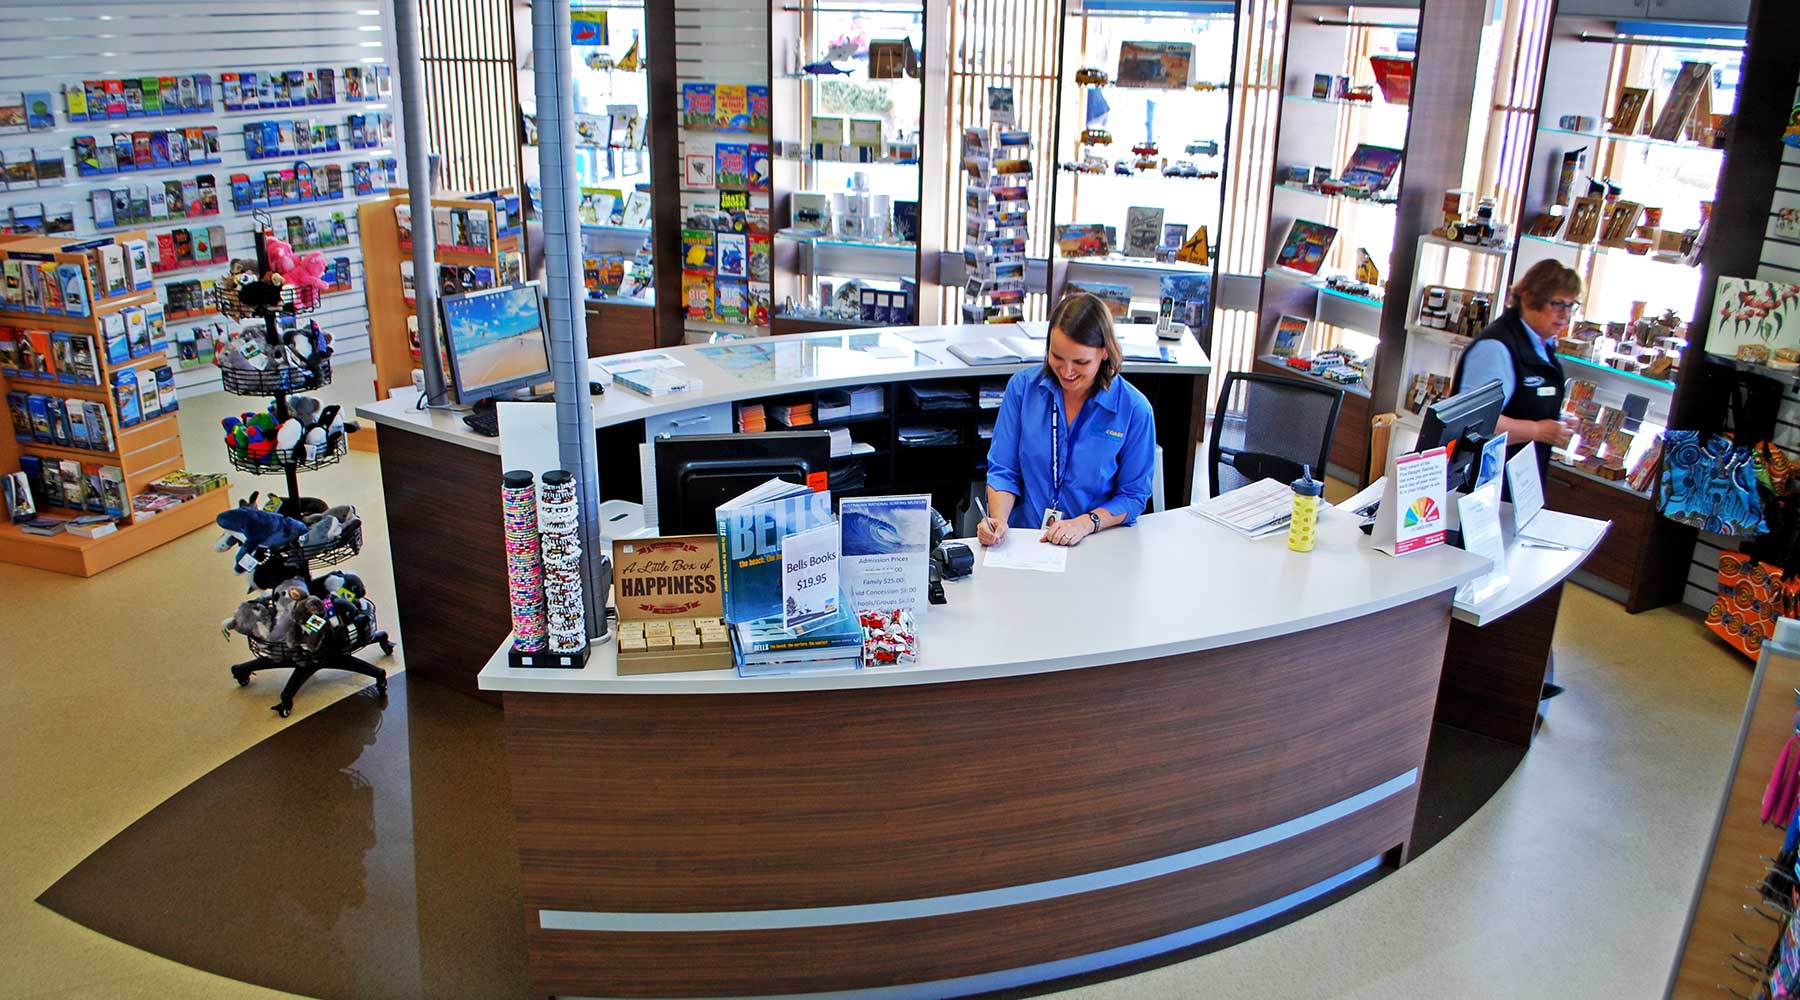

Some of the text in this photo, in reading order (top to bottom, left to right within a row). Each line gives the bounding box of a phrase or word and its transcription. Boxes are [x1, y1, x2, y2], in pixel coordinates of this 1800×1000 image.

[688, 288, 708, 300] BIG
[721, 287, 740, 299] BIG
[729, 491, 831, 561] BELLS
[739, 560, 749, 569] the
[786, 550, 837, 574] Bells Books
[858, 556, 890, 564] Admission
[622, 558, 714, 575] A Little Box of
[621, 574, 717, 598] HAPPINESS
[796, 573, 827, 592] $19.95
[883, 577, 905, 585] $25.00
[866, 588, 900, 596] Concession
[753, 643, 769, 653] BELLS
